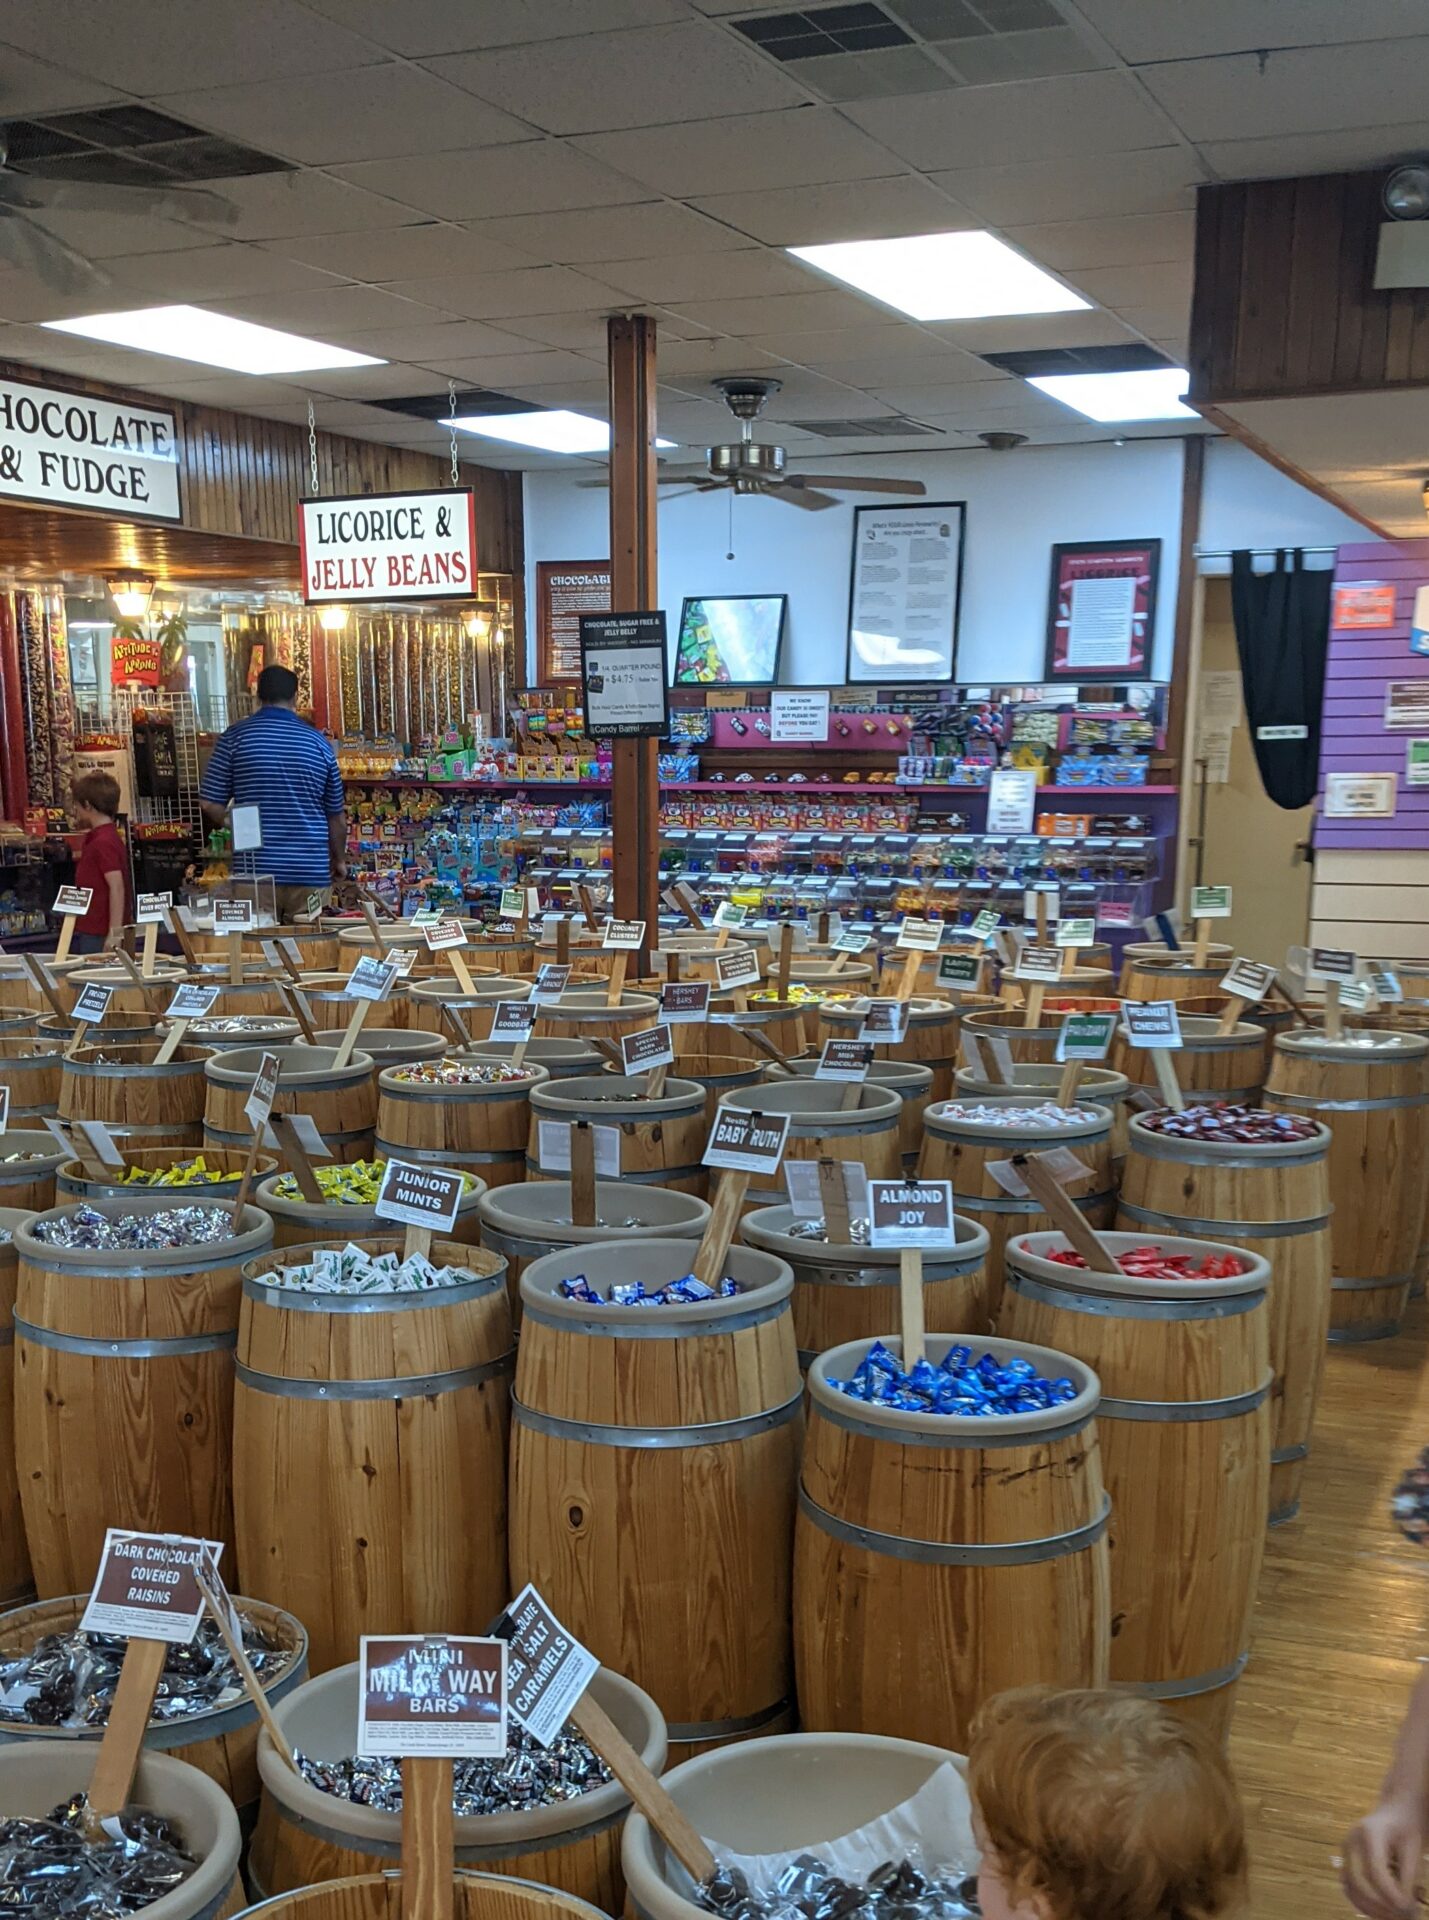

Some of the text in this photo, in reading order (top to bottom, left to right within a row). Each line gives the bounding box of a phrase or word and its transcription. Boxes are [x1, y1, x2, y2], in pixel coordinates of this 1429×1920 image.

[0, 445, 150, 503] & FUDGE
[316, 505, 452, 545] LICORICE &
[311, 550, 467, 591] JELLY BEANS
[604, 628, 638, 637] JELLY BELLY
[113, 642, 151, 660] ATTITUDE
[611, 663, 640, 672] QUARTER
[611, 674, 635, 684] $4.75
[594, 724, 640, 734] Candy Barrel
[1127, 1006, 1169, 1017] PEANUT
[631, 1045, 666, 1061] CHOCOLATE
[639, 1043, 656, 1052] DARK
[832, 1043, 866, 1051] HERSHEY
[823, 1060, 864, 1068] CHOCOLATE
[716, 1123, 782, 1149] BABY RUTH
[396, 1170, 452, 1195] JUNIOR
[395, 1187, 443, 1210] MINTS
[880, 1189, 944, 1205] ALMOND
[899, 1210, 926, 1225] JOY
[114, 1542, 201, 1566] DARK CHOCOLAT
[131, 1566, 181, 1585] COVERED
[127, 1587, 172, 1606] RAISINS
[408, 1648, 463, 1665] MINI
[508, 1620, 549, 1690] SEA SALT
[447, 1669, 498, 1694] WAY
[515, 1636, 568, 1713] CARAMELS
[409, 1698, 460, 1714] BARS
